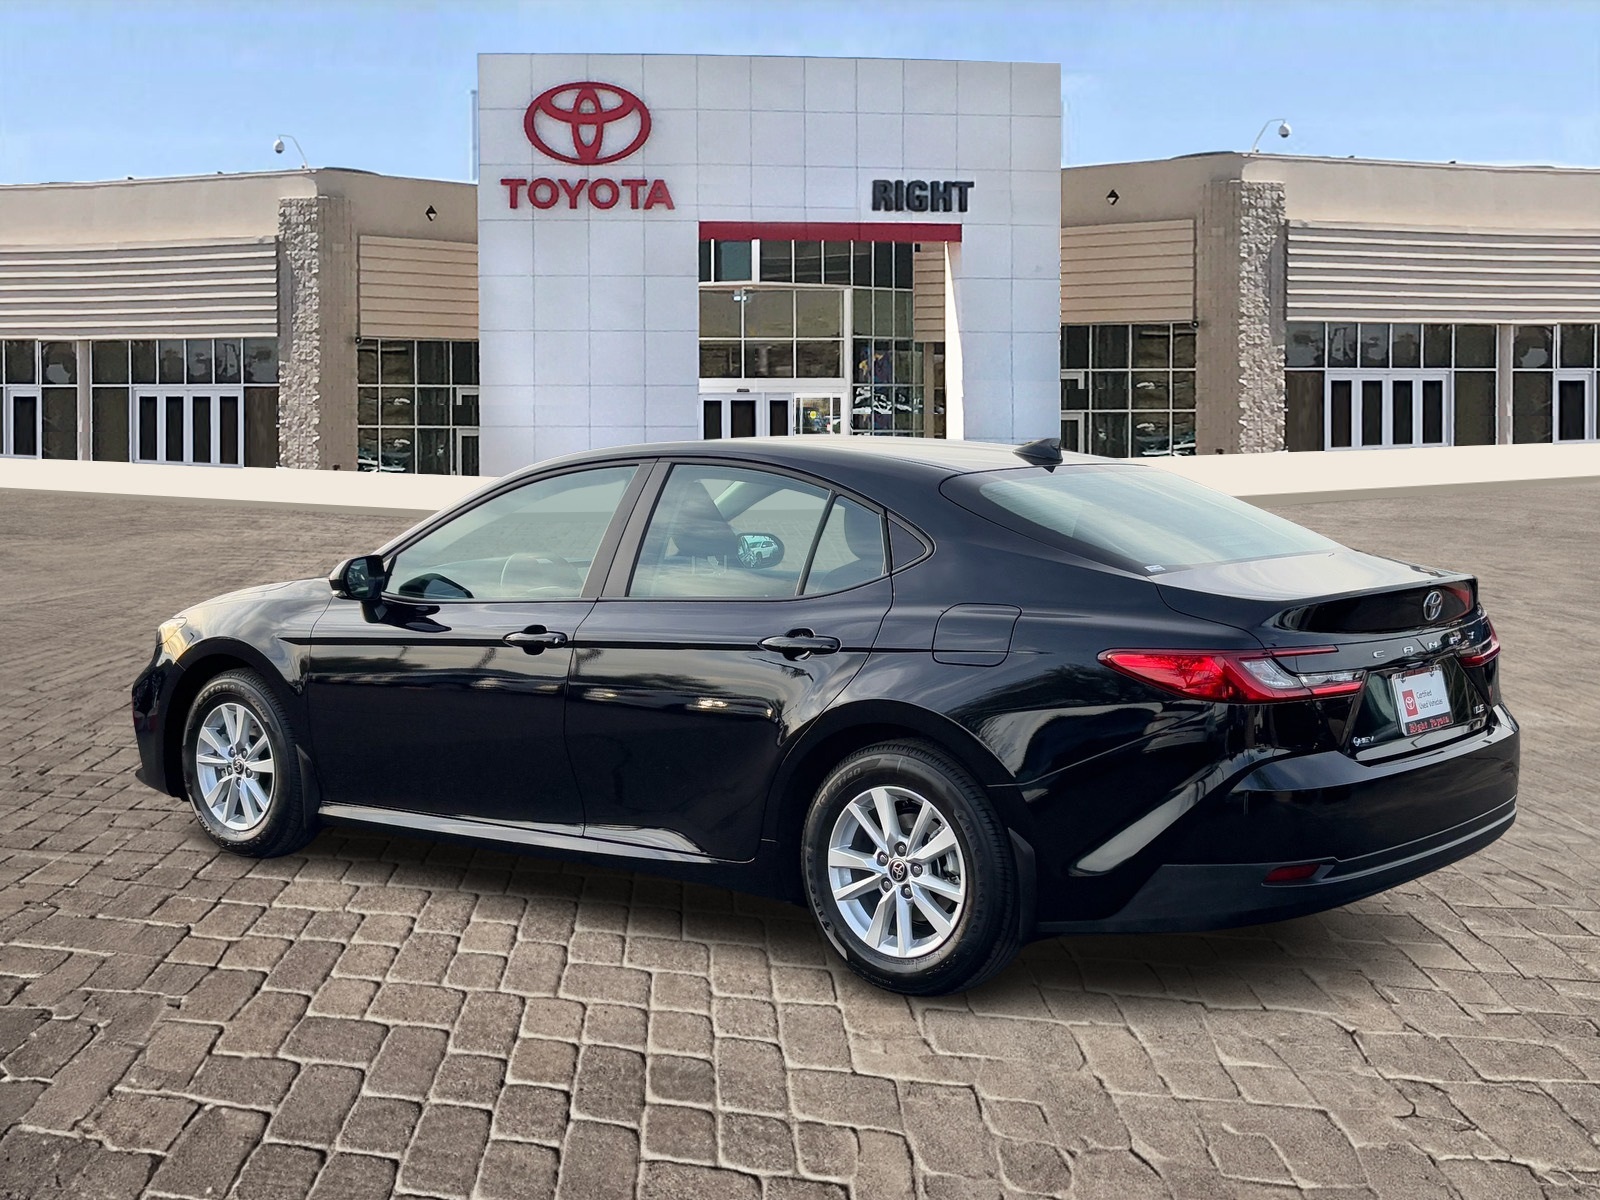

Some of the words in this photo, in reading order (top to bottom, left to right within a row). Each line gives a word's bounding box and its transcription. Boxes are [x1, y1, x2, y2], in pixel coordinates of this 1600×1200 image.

[500, 178, 675, 209] TOYOTA
[872, 180, 974, 212] RIGHT
[1373, 631, 1475, 658] CAMRY
[1416, 689, 1432, 699] Certified
[1419, 701, 1429, 710] Used
[1429, 698, 1443, 708] Vehicles
